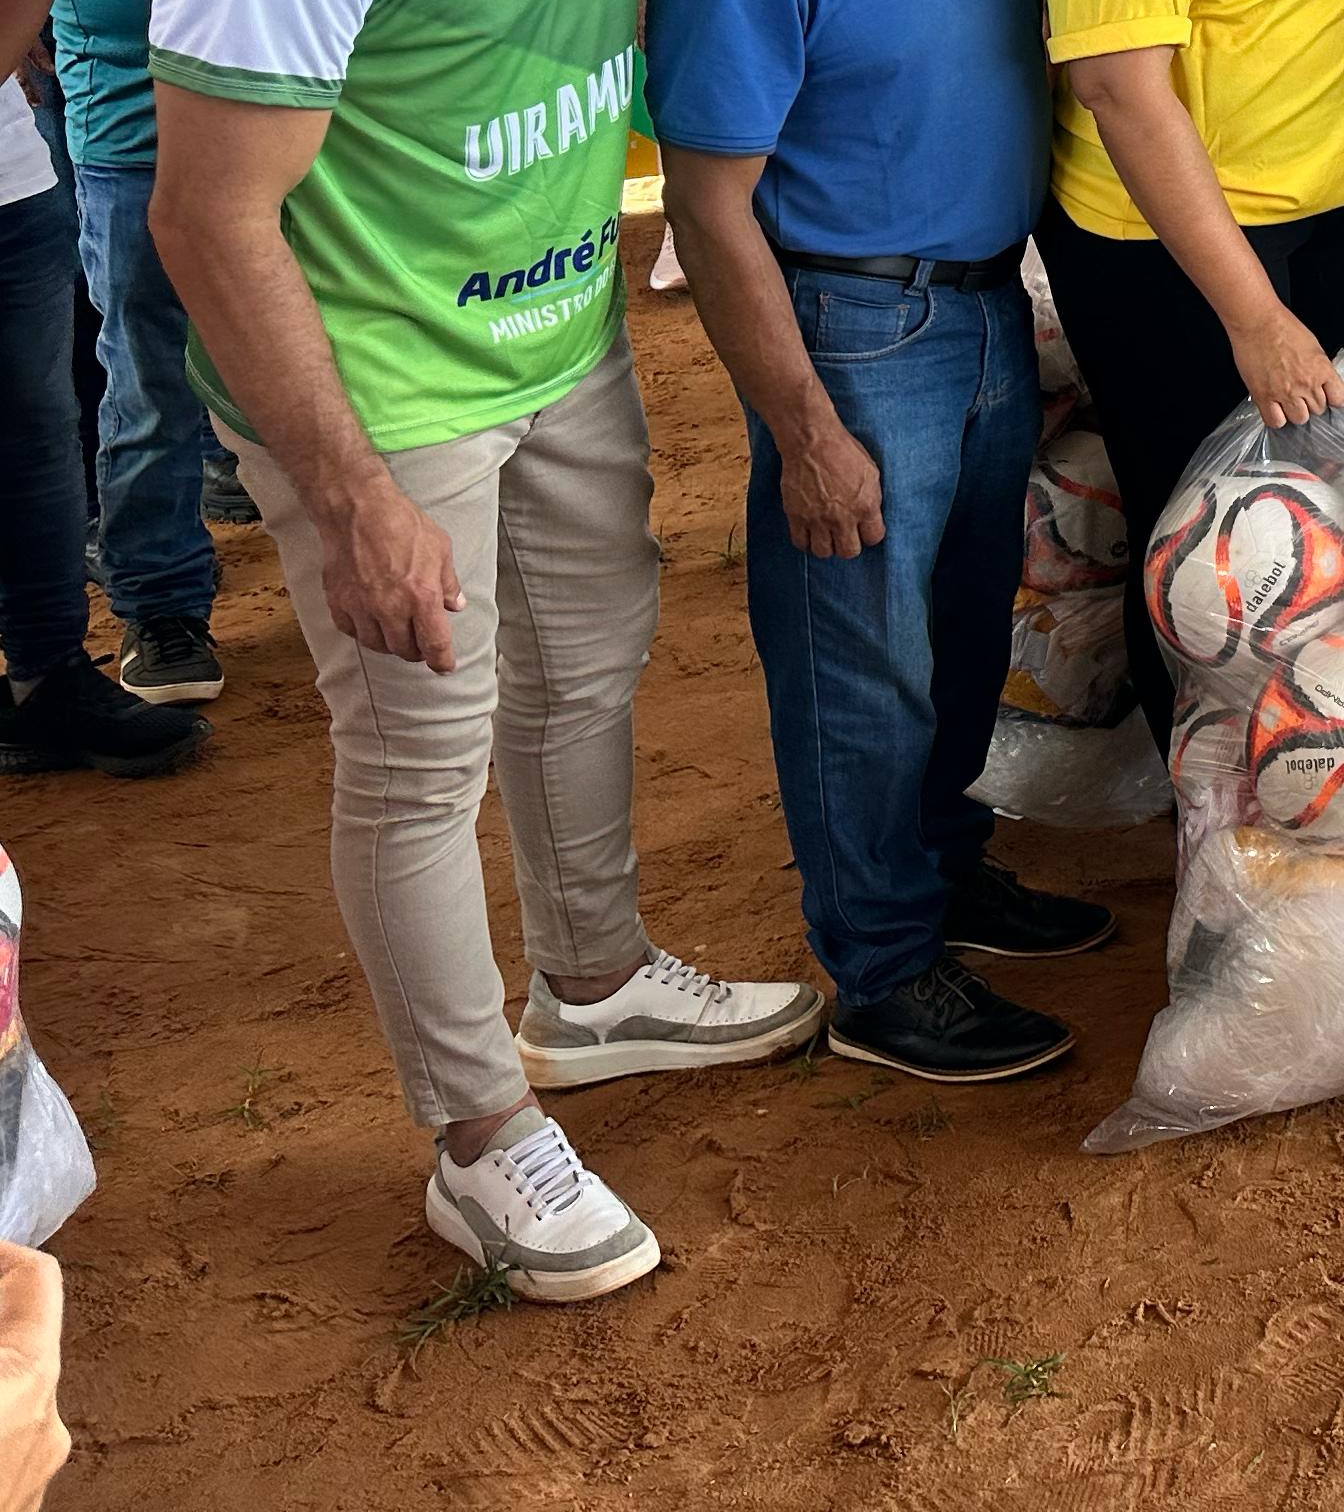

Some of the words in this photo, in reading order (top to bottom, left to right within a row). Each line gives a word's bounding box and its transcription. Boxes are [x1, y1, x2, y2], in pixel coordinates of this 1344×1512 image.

[464, 44, 633, 182] UIRAMU
[457, 228, 595, 307] André
[488, 286, 593, 344] MINISTRO
[1245, 560, 1287, 613] dalebol
[1286, 757, 1335, 774] dalebol
